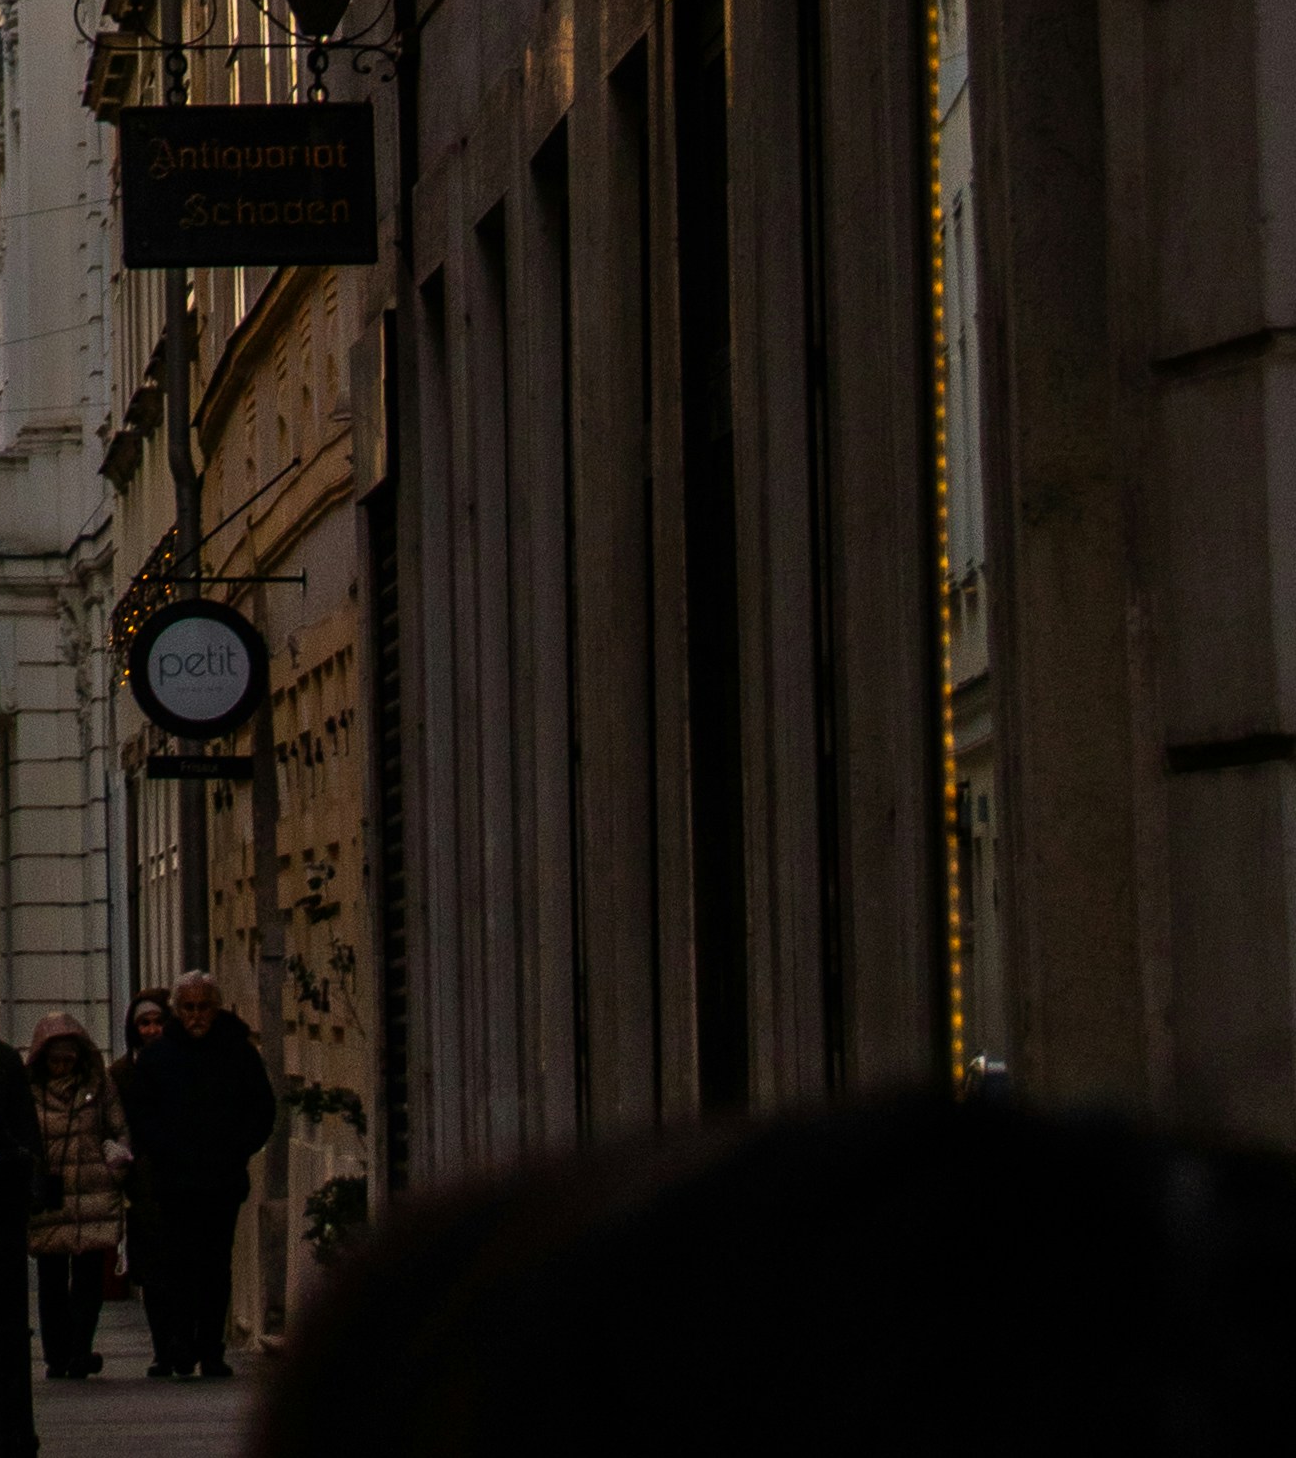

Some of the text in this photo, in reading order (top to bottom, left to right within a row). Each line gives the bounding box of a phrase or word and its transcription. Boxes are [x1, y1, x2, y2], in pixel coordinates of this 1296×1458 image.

[148, 136, 348, 181] Antiquariat
[178, 192, 351, 230] Schaden
[159, 644, 238, 686] petit
